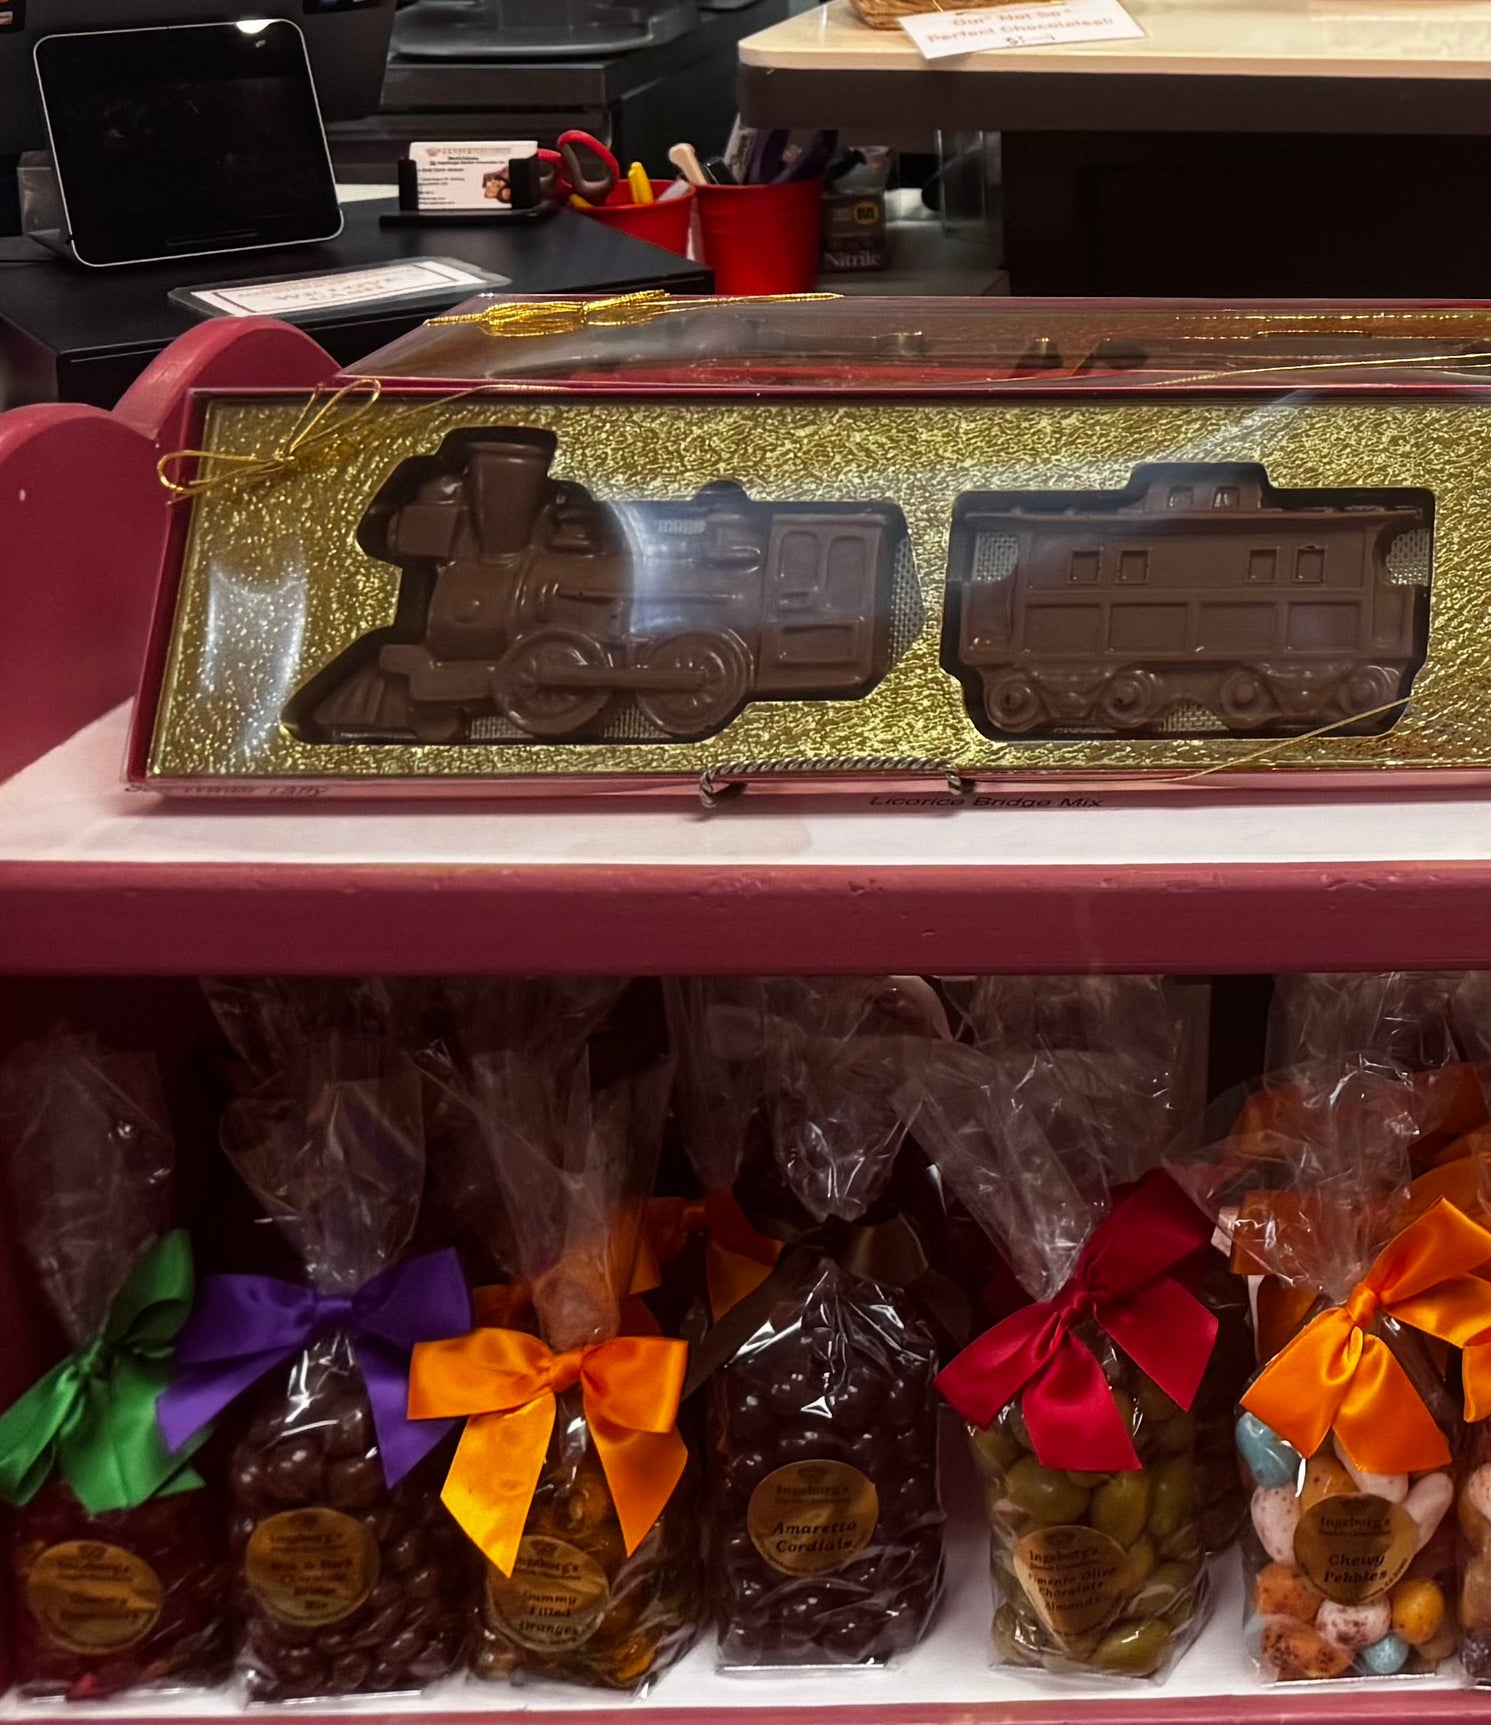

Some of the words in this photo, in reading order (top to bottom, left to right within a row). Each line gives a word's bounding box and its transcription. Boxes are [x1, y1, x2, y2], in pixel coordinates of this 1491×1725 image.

[824, 249, 881, 270] Nitrile
[869, 796, 964, 806] Licorice
[972, 796, 1050, 808] Bridge
[1058, 798, 1103, 808] Mix
[772, 1521, 858, 1536] Amaretto
[776, 1538, 853, 1553] Cordials
[1328, 1554, 1385, 1567] Chewy
